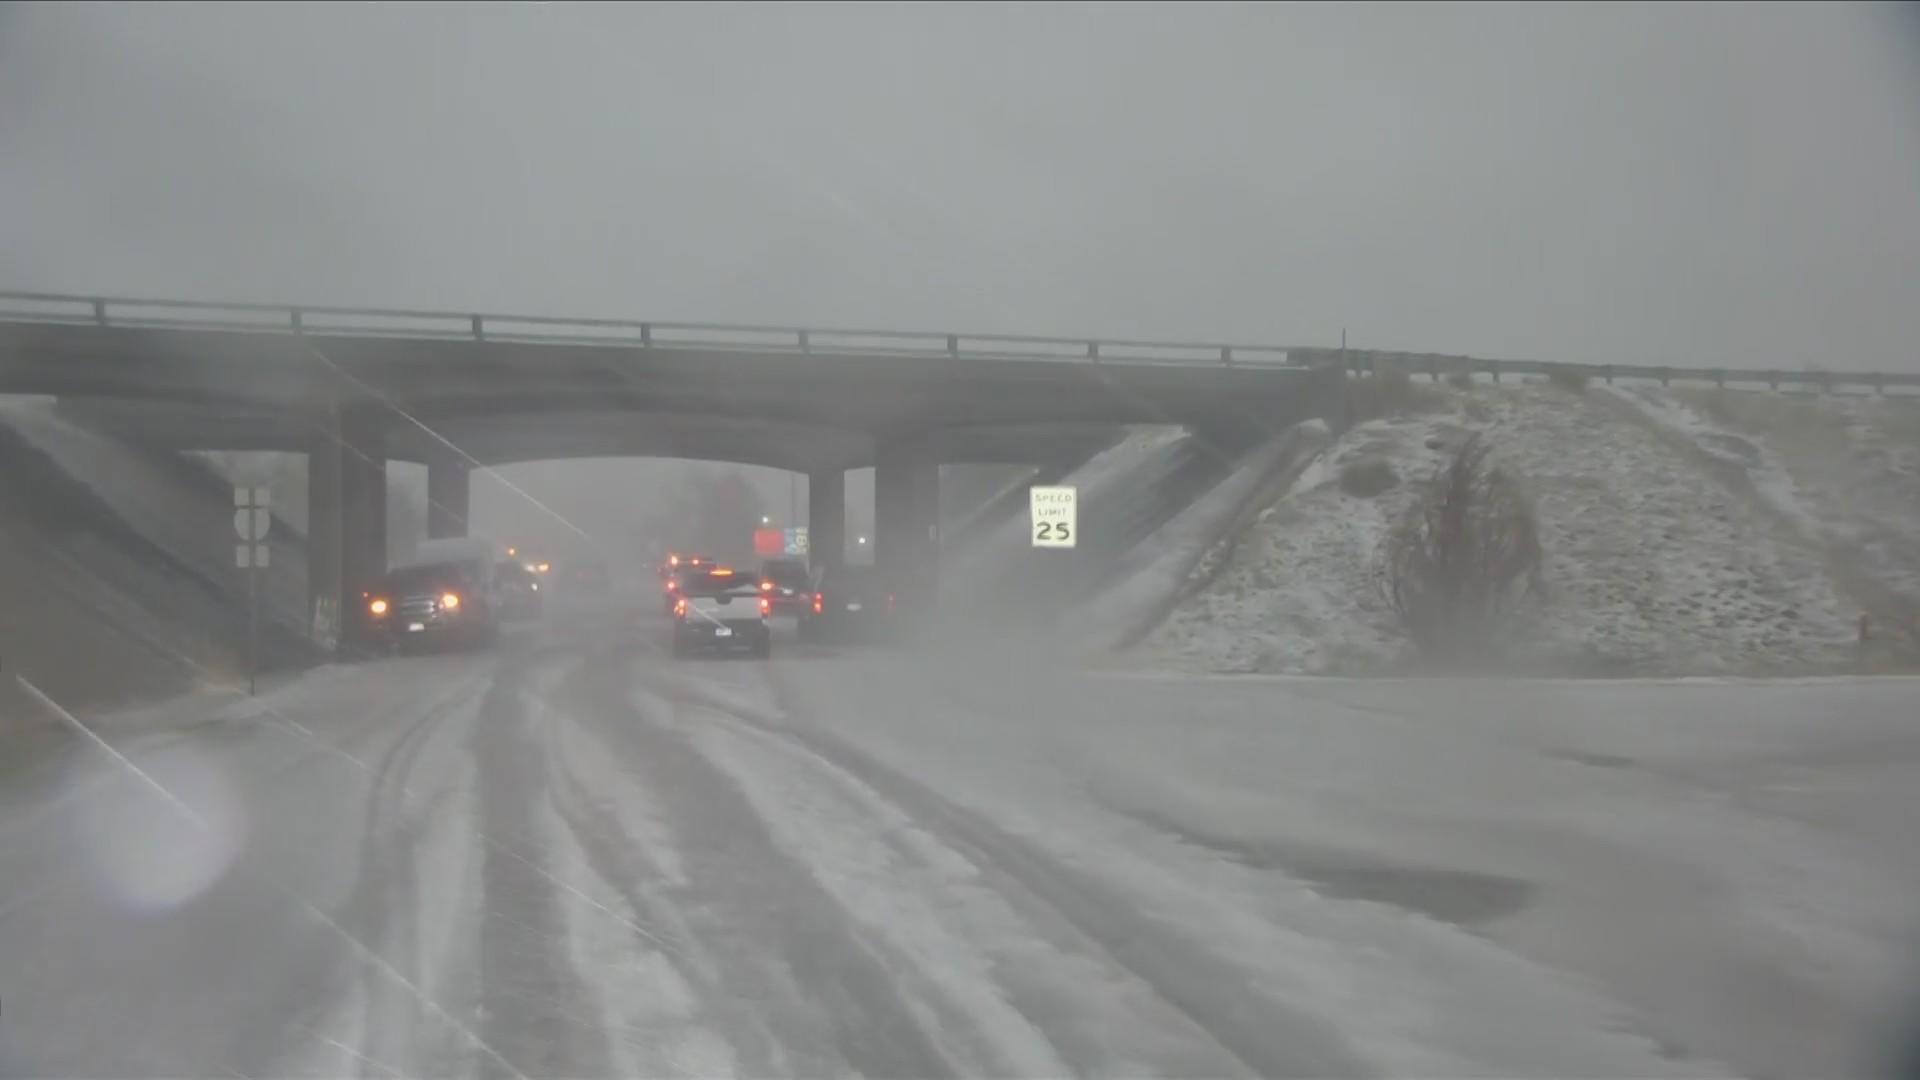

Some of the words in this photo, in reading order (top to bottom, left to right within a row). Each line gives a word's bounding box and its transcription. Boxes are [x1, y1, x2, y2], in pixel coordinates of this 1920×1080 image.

[1035, 494, 1072, 503] SPEED
[1038, 507, 1067, 517] LIMIT
[1036, 521, 1070, 541] 25
